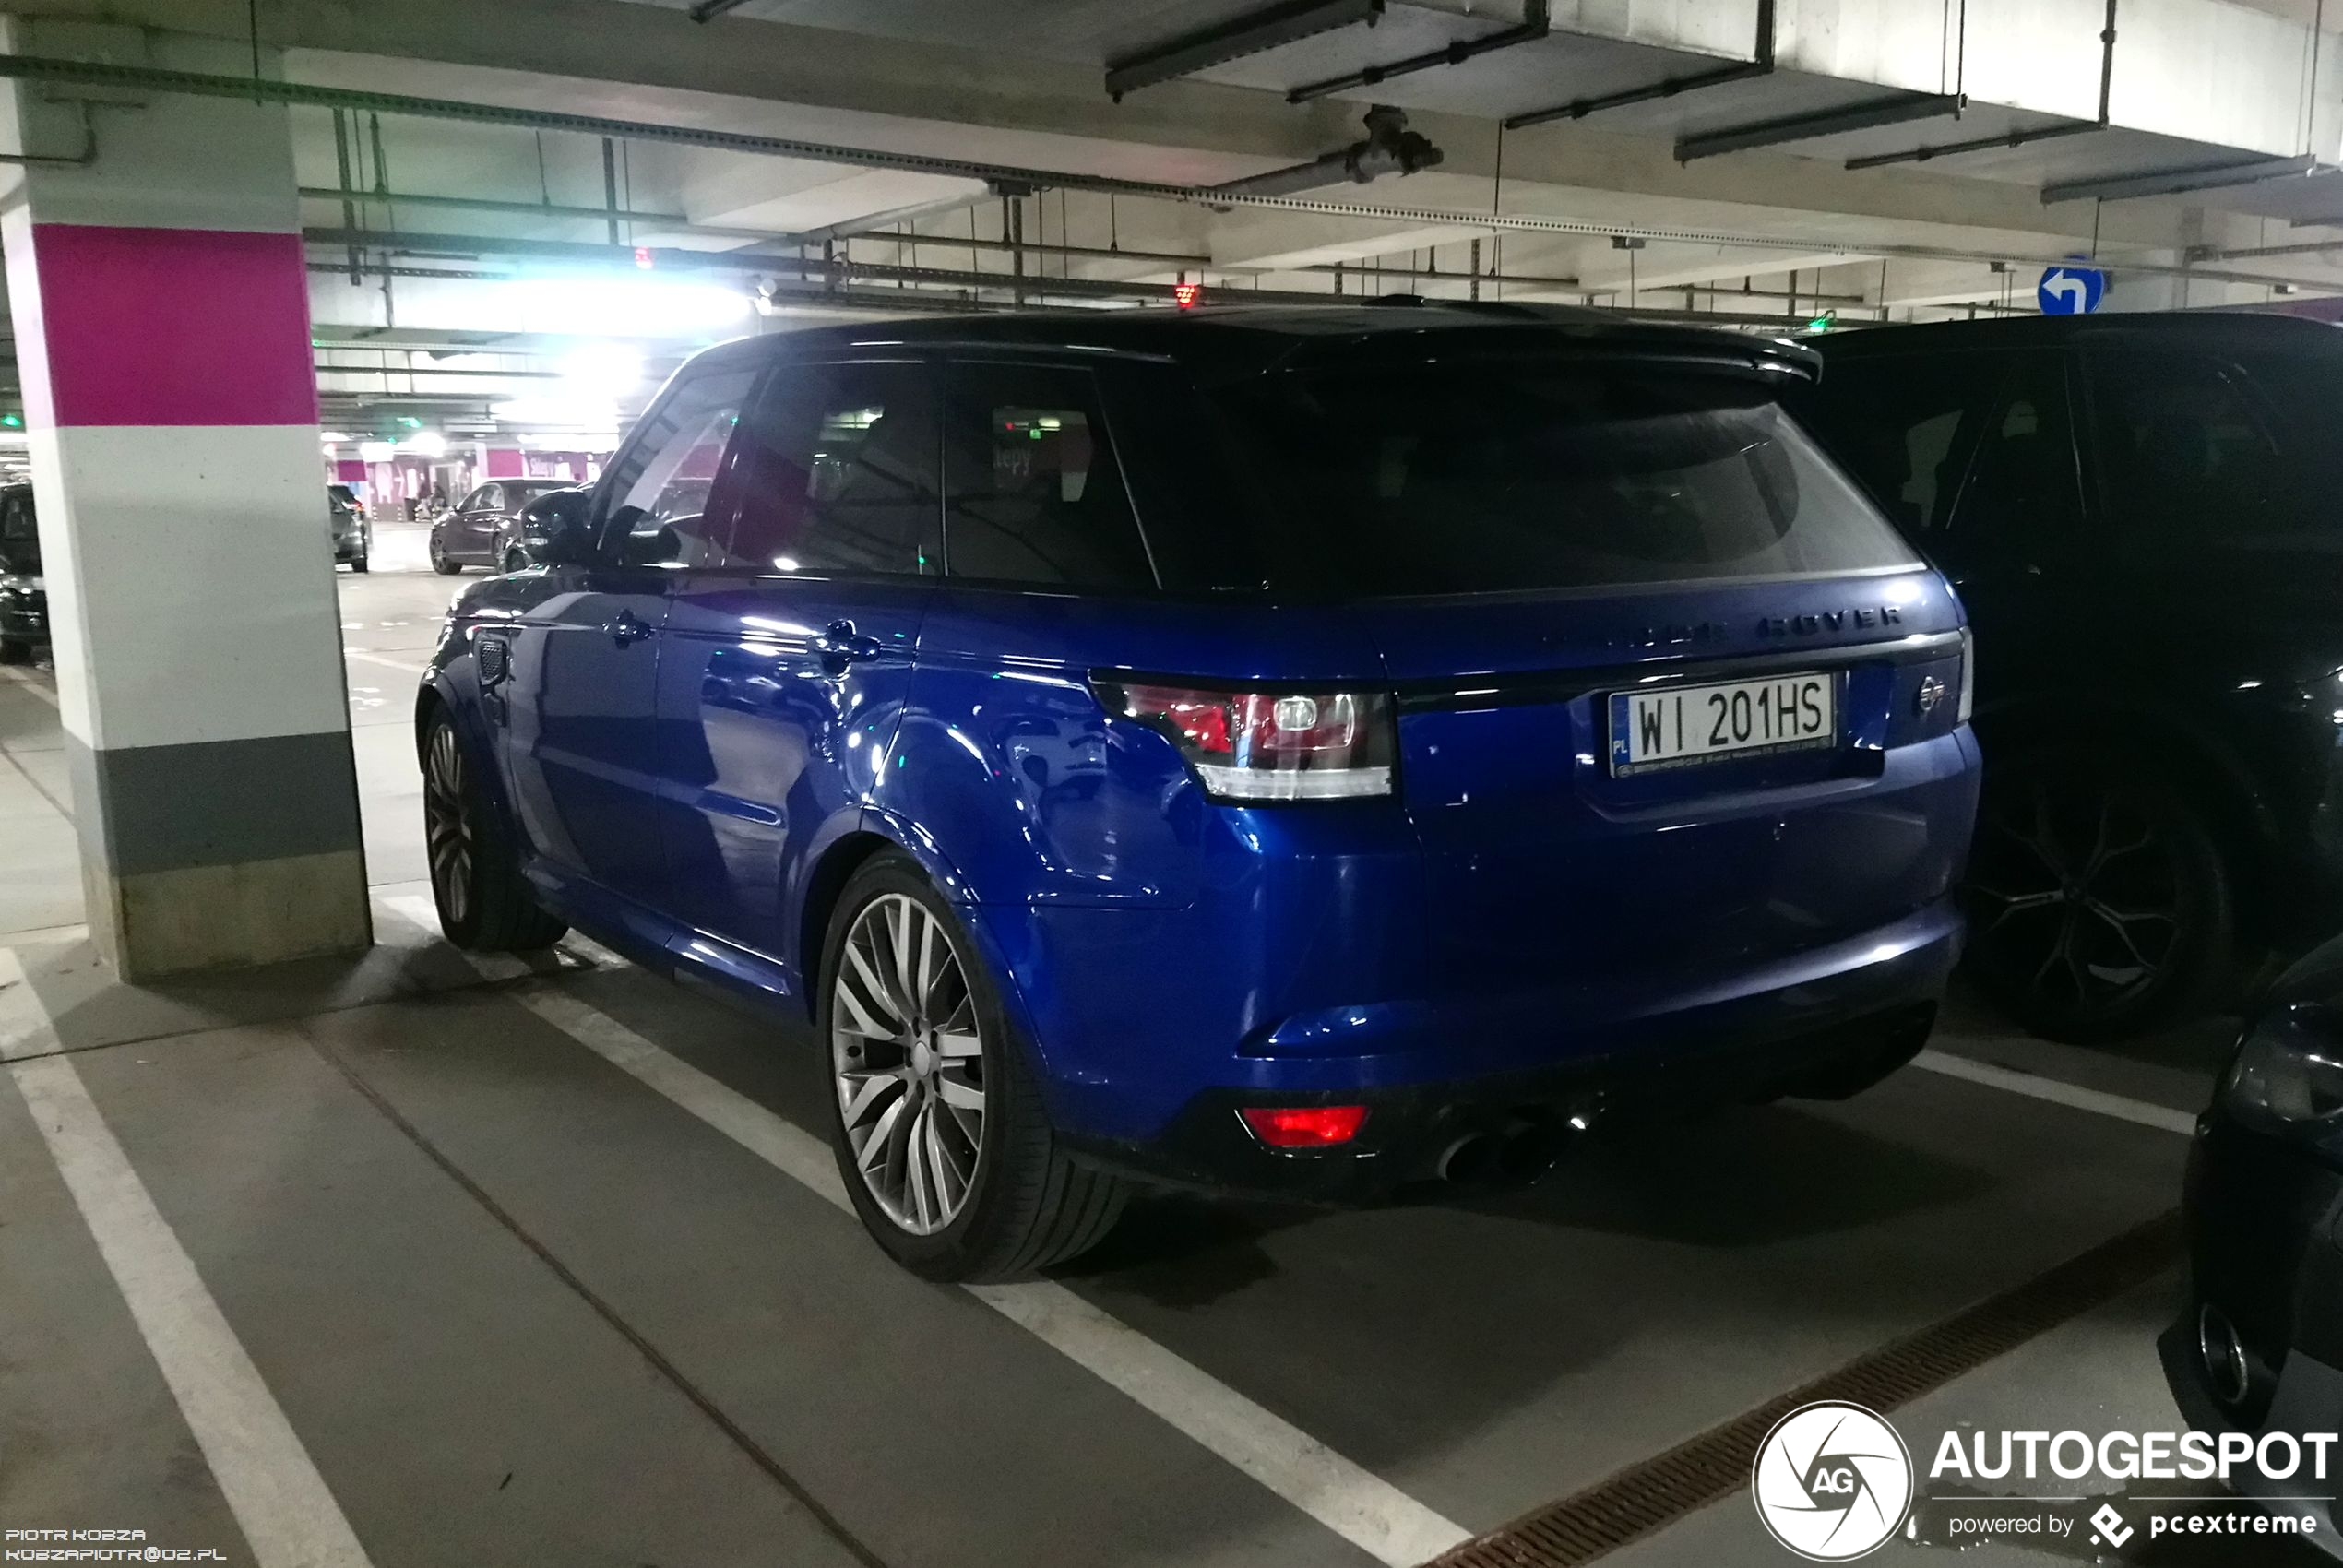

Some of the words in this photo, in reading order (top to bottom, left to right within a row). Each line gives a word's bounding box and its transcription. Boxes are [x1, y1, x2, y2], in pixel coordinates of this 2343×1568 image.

[1755, 606, 1901, 638] ROVER
[1639, 695, 1683, 755] WI
[1708, 682, 1822, 747] 201HS
[1613, 740, 1628, 754] PL
